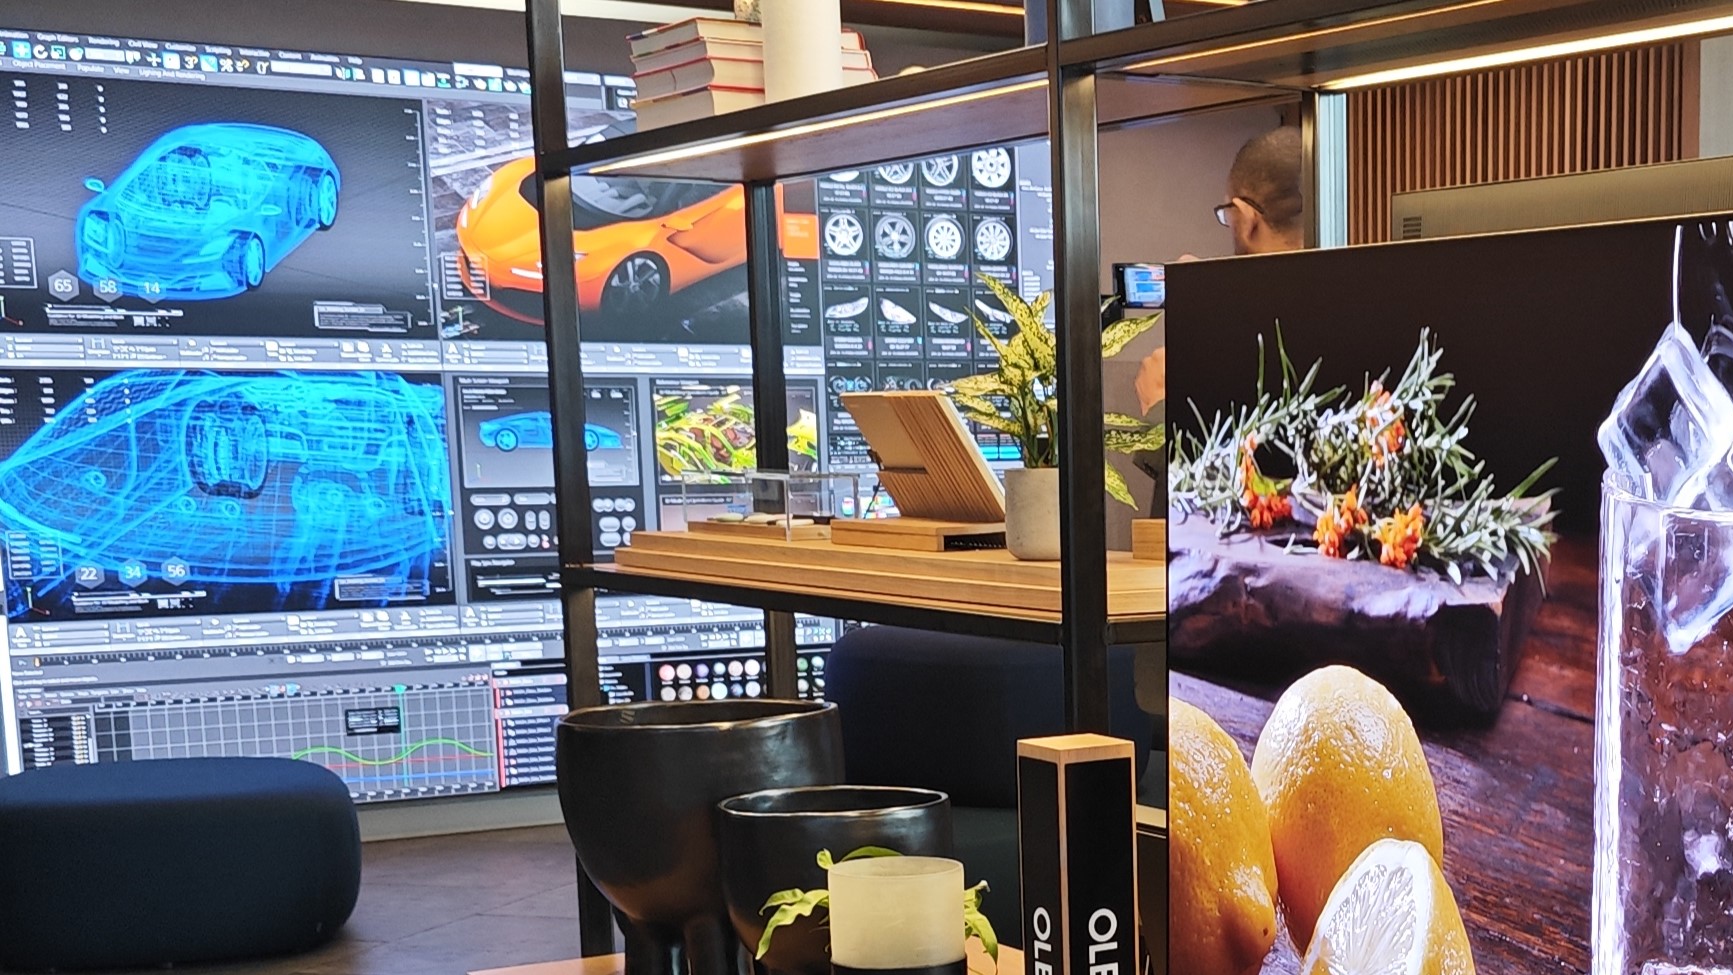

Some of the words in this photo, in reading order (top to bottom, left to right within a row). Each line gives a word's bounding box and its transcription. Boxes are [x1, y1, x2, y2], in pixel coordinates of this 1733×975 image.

[53, 279, 72, 292] 65
[144, 281, 160, 293] 14
[80, 568, 97, 580] 22
[125, 566, 141, 578] 34
[167, 565, 185, 578] 56
